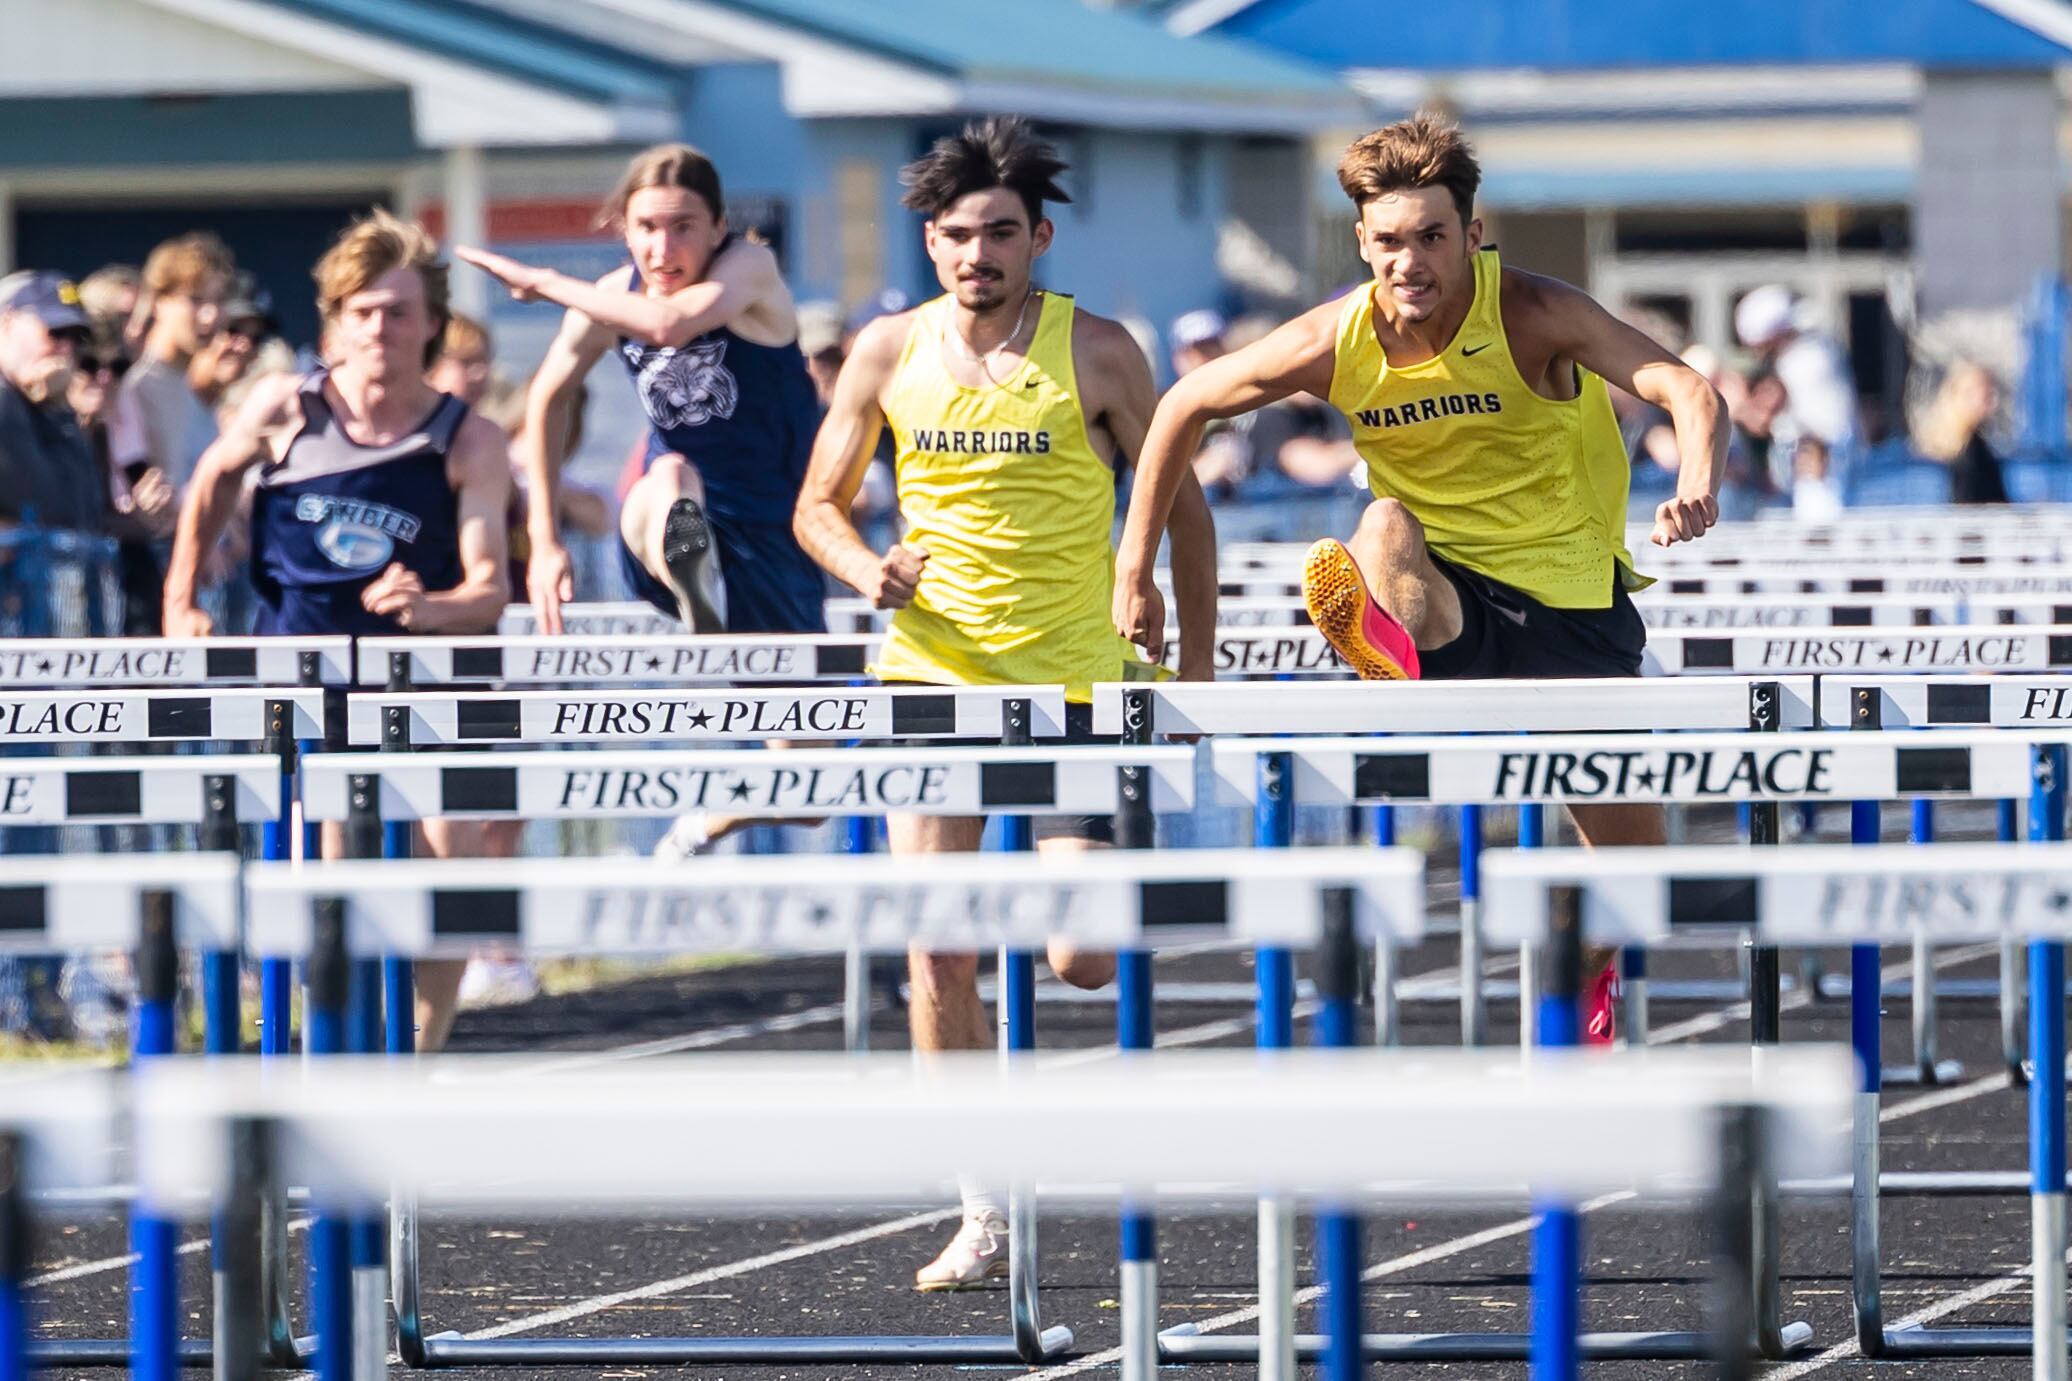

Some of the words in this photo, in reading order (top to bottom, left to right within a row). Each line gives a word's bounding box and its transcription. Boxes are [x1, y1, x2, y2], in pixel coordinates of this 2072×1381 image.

[1355, 393, 1502, 427] WARRIORS
[914, 429, 1050, 454] WARRIORS
[61, 649, 187, 679] PLACE
[530, 649, 643, 677] FIRST
[670, 646, 797, 676] PLACE
[1761, 640, 1874, 668] FIRST
[1902, 638, 2026, 667] PLACE
[0, 701, 125, 735] LACE
[550, 701, 688, 735] FIRST
[717, 698, 869, 733] PLACE
[557, 770, 721, 810] FIRST
[766, 766, 952, 807] PLACE
[1493, 751, 1644, 798] FIRST
[1660, 749, 1836, 796] PLACE
